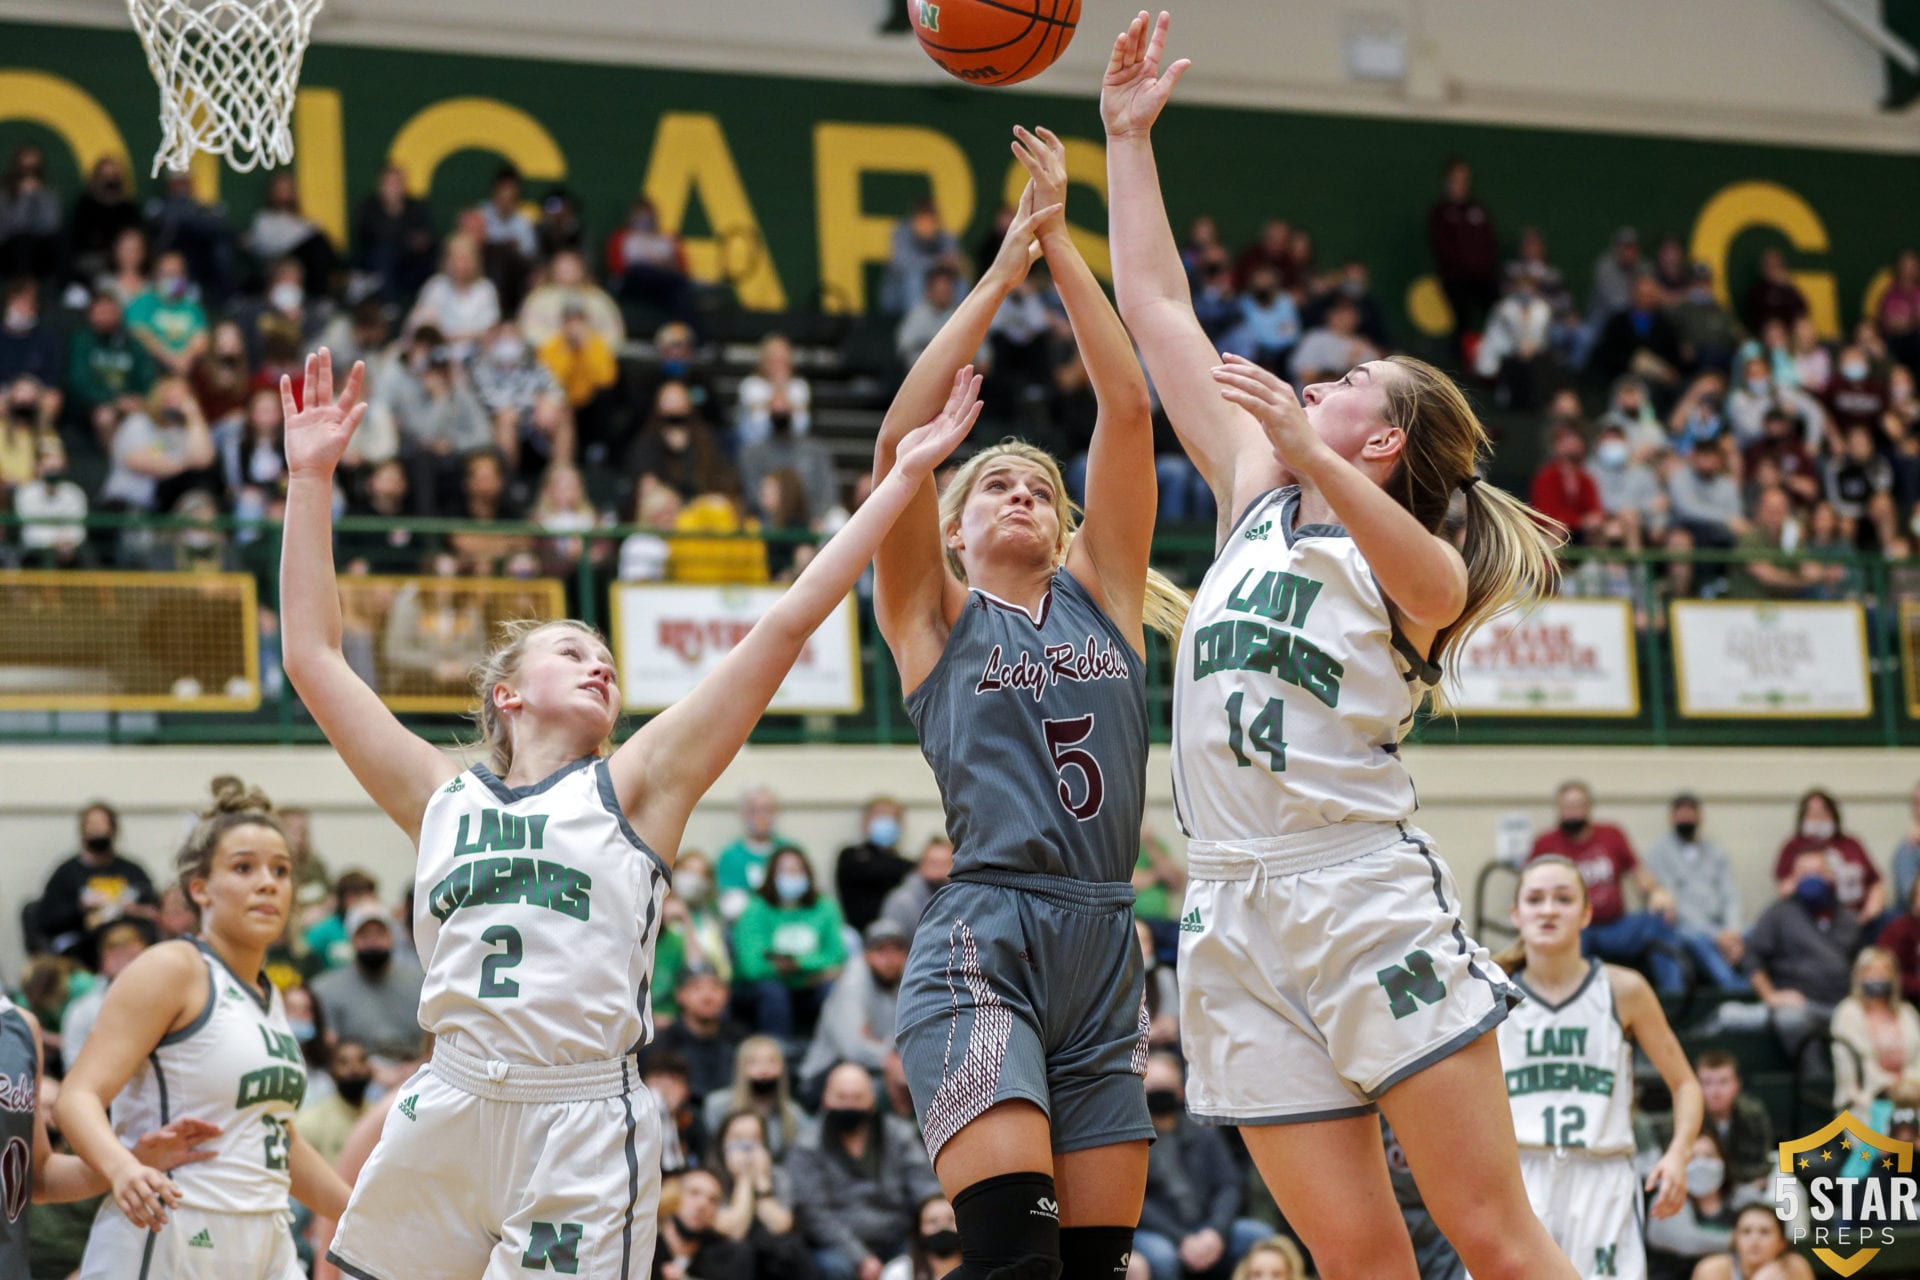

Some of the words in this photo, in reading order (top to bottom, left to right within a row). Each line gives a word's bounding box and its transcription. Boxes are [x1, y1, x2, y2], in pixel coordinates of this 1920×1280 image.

[919, 3, 940, 33] N
[1226, 568, 1324, 629] LADY
[1044, 635, 1128, 687] Rebels
[1194, 620, 1344, 708] COUGARS
[1225, 692, 1288, 771] 14
[1042, 713, 1105, 822] 5
[454, 808, 550, 857] LADY
[429, 857, 592, 926] COUGARS
[478, 925, 523, 998] 2
[1376, 949, 1447, 1020] N
[1525, 1027, 1589, 1057] LADY
[1505, 1063, 1615, 1097] COUGARS
[1541, 1106, 1586, 1148] 12
[521, 1222, 584, 1275] N
